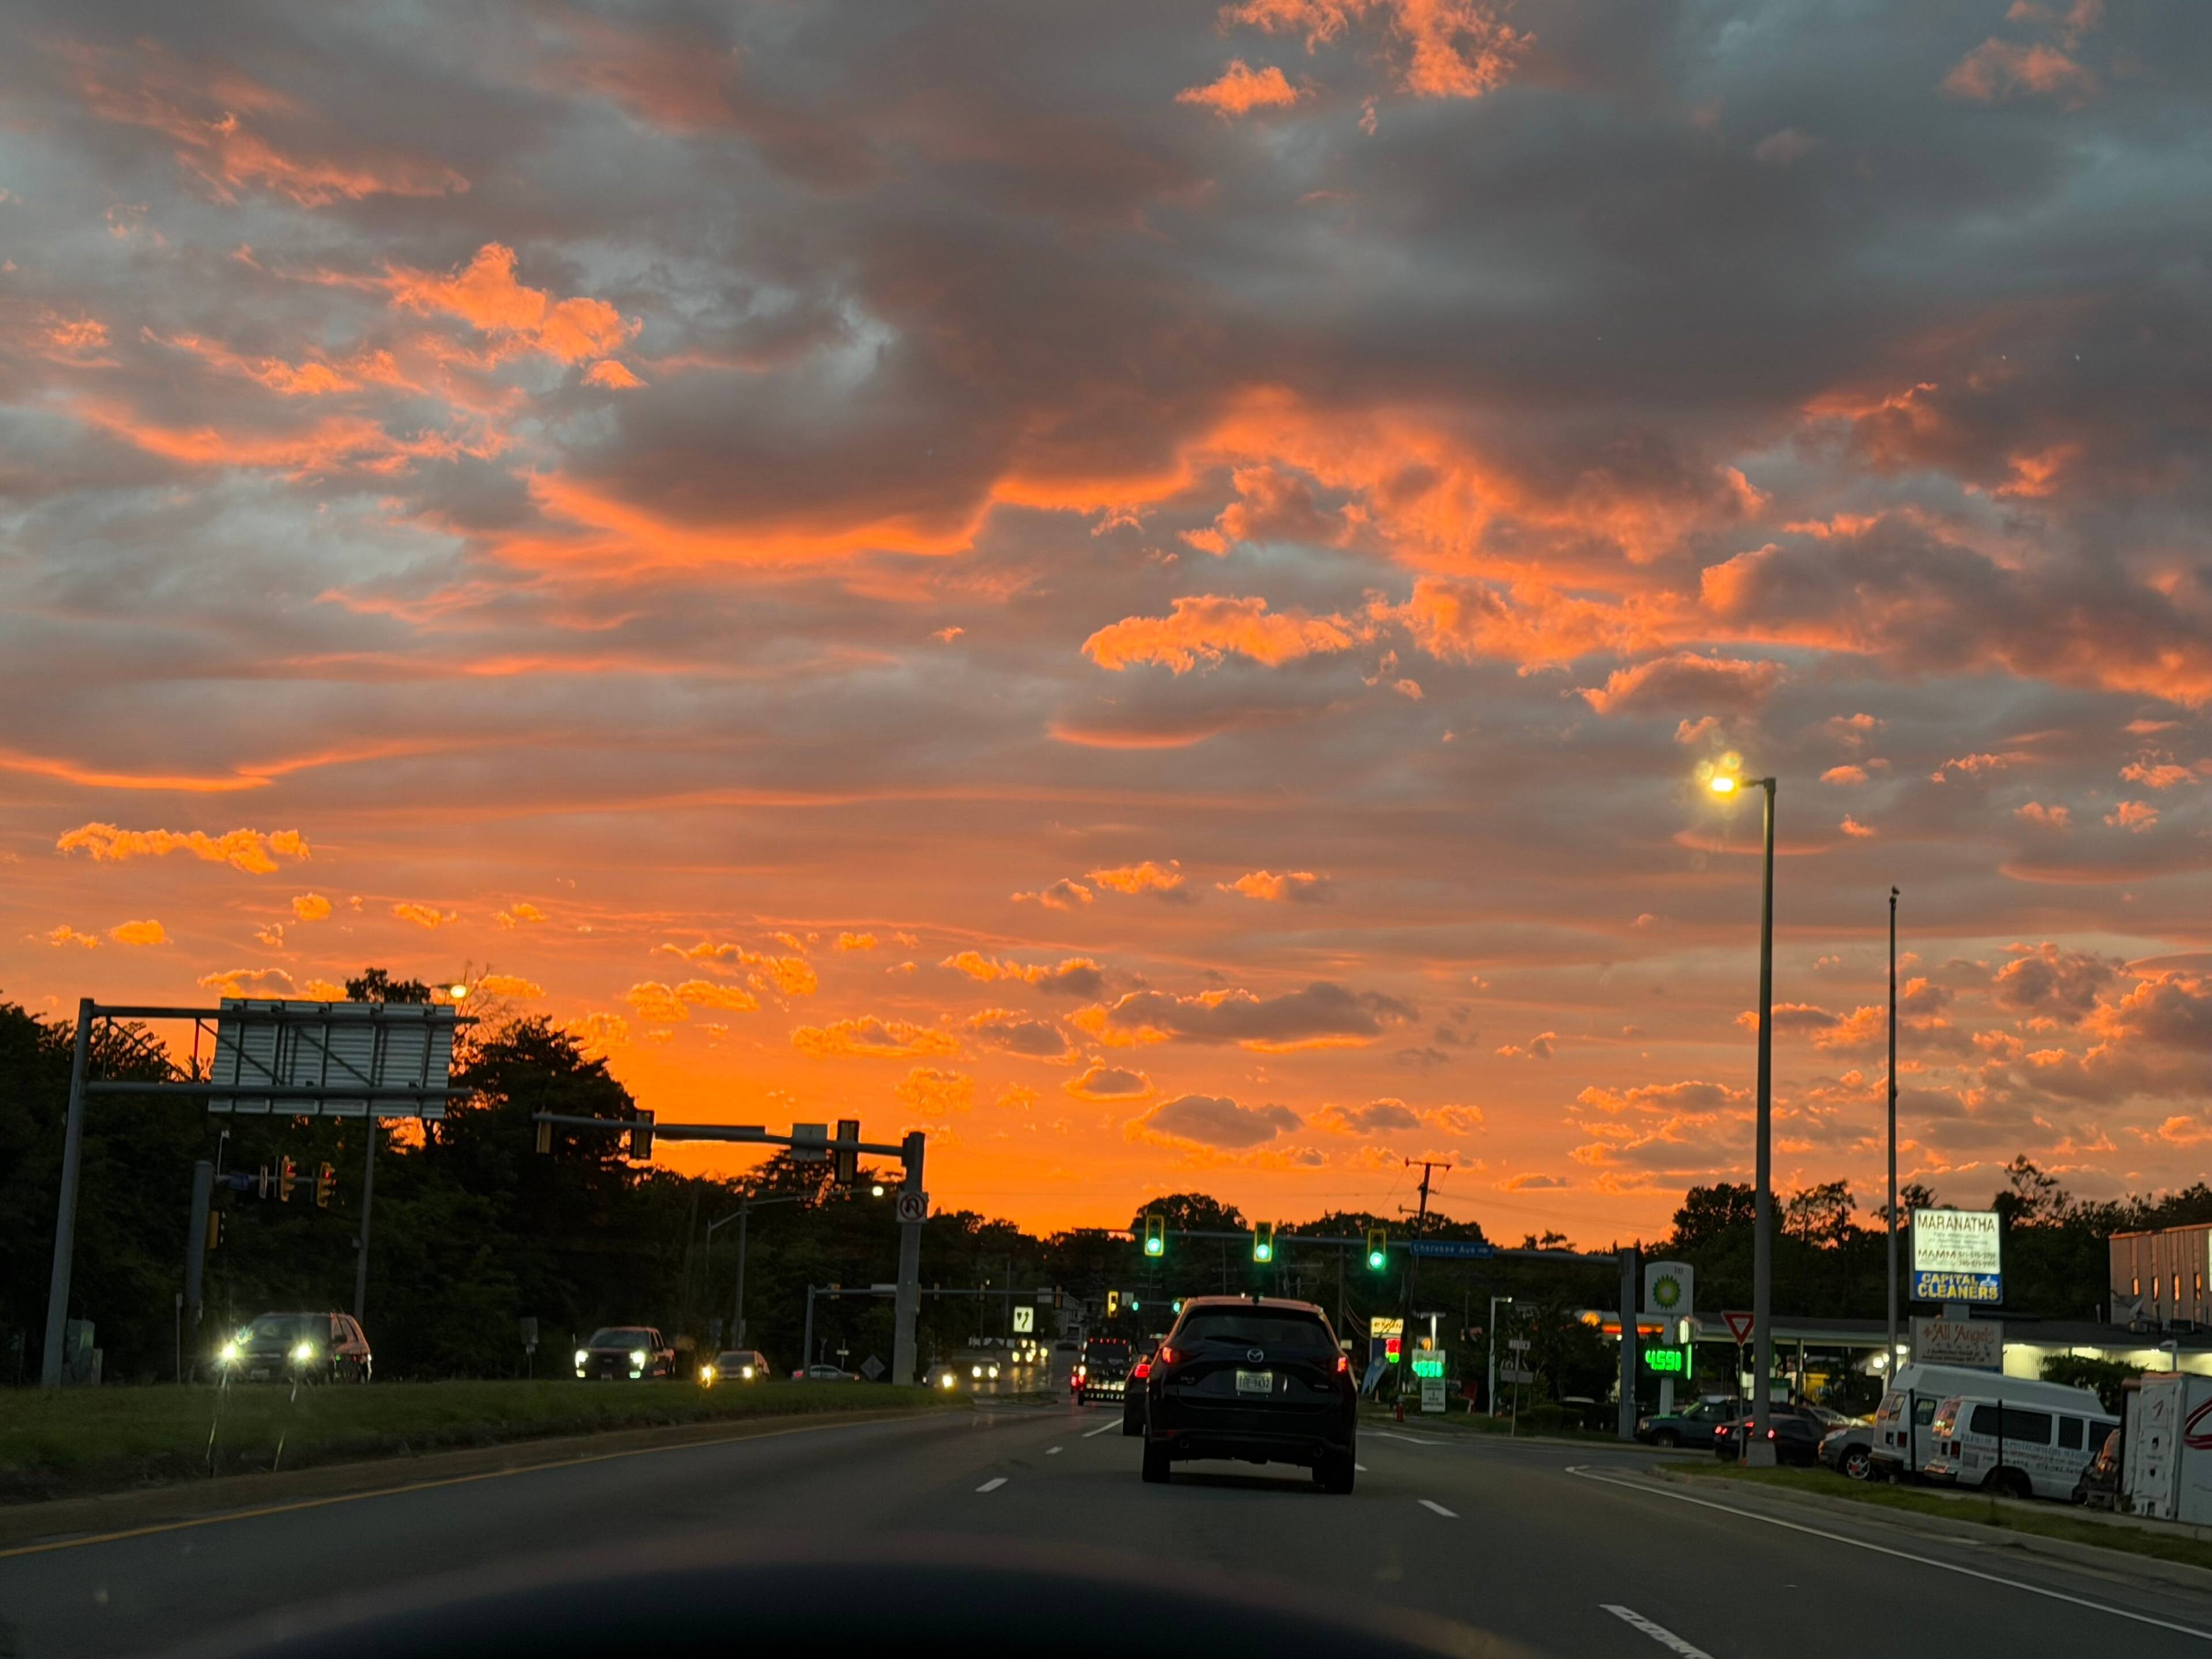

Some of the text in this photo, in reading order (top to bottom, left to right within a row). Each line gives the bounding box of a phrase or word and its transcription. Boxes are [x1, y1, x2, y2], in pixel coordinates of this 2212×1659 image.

[1918, 1214, 1995, 1232] MARANATHA
[1922, 1272, 1978, 1286] CAPITAL
[1918, 1282, 1998, 1300] CLEANERS
